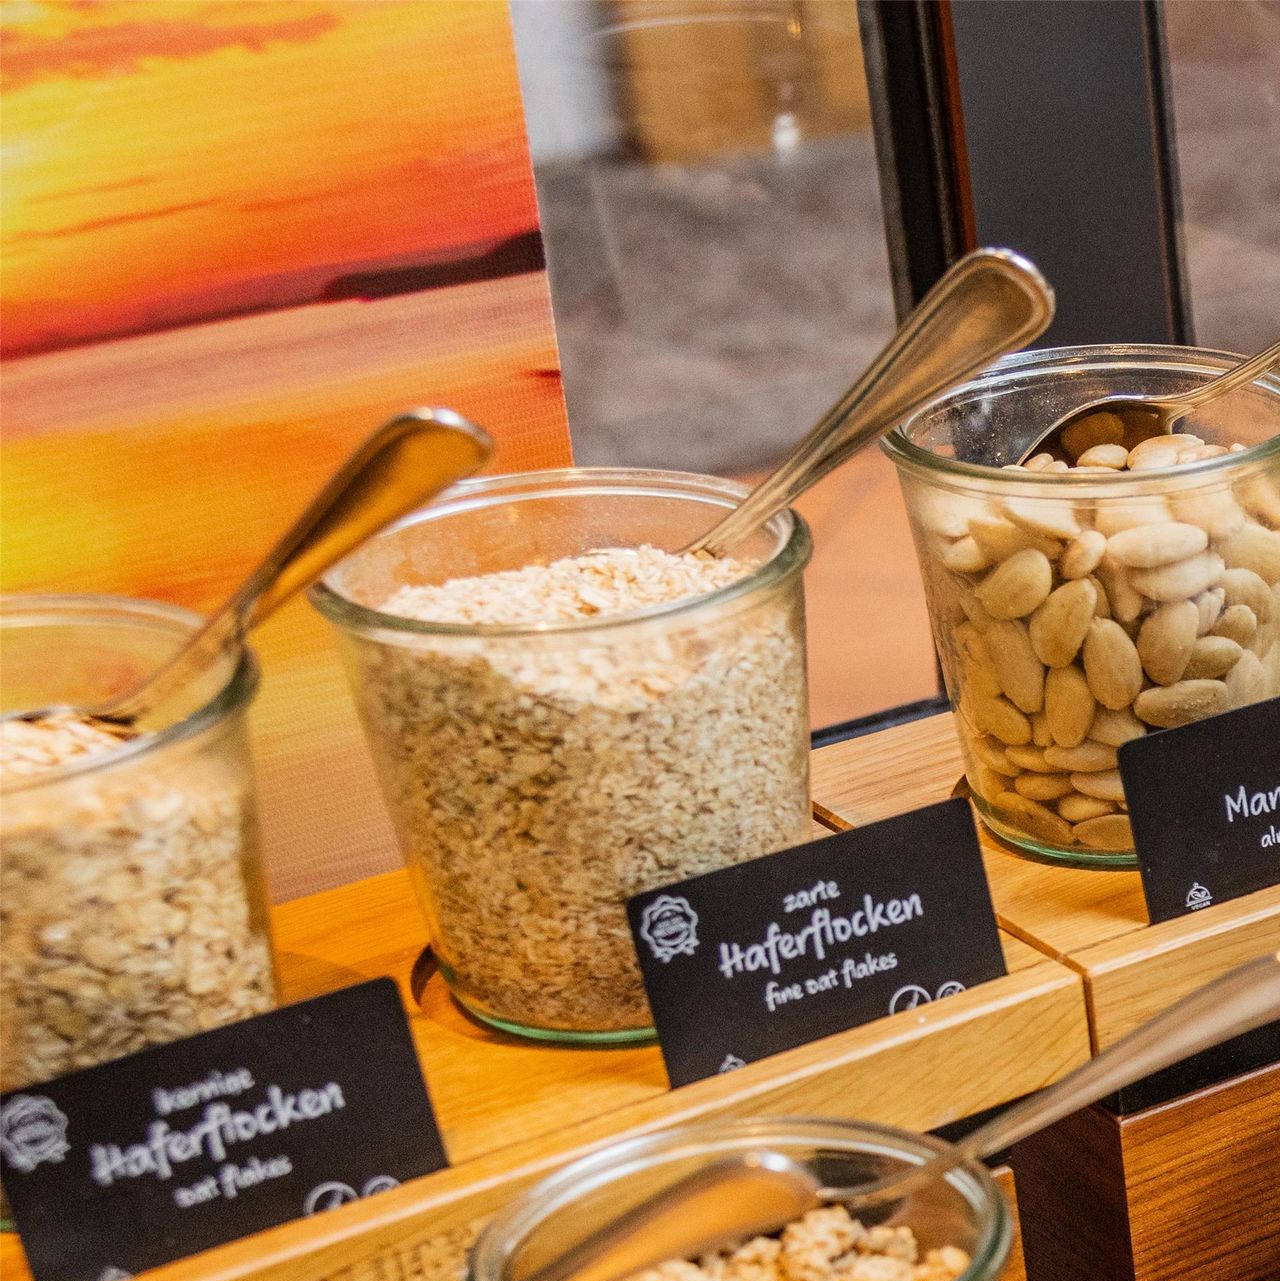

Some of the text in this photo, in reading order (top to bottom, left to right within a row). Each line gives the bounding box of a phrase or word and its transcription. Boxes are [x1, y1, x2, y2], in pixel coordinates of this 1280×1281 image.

[783, 880, 840, 914] zarte
[719, 894, 924, 978] Haferflocken
[765, 952, 898, 1012] fine oat flakes
[89, 1082, 346, 1187] Haferflocken
[219, 1155, 293, 1199] flakes
